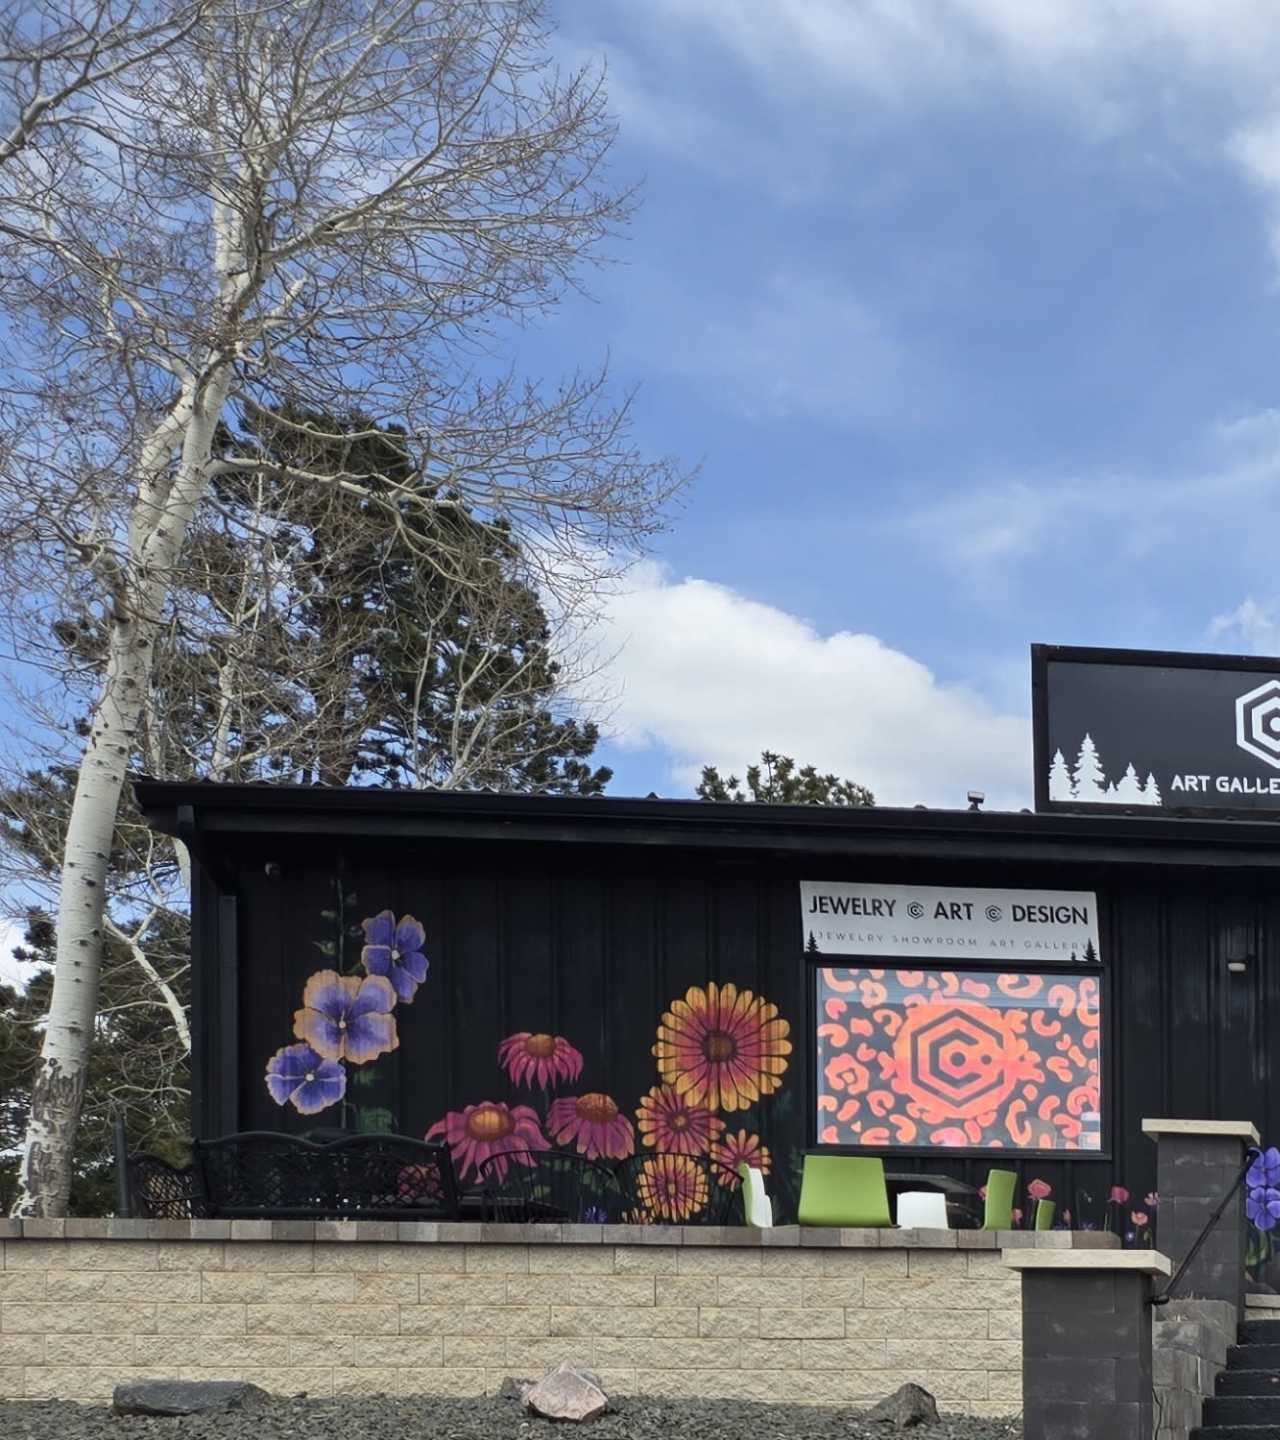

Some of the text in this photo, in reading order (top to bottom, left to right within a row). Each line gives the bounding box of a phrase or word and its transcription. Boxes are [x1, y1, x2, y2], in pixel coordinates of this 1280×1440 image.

[1171, 774, 1210, 792] ART
[809, 895, 1089, 925] JEWELRY ART DESIGN
[819, 931, 884, 942] JEWELRY
[892, 935, 977, 946] SHOWROOM
[990, 939, 1014, 948] ART
